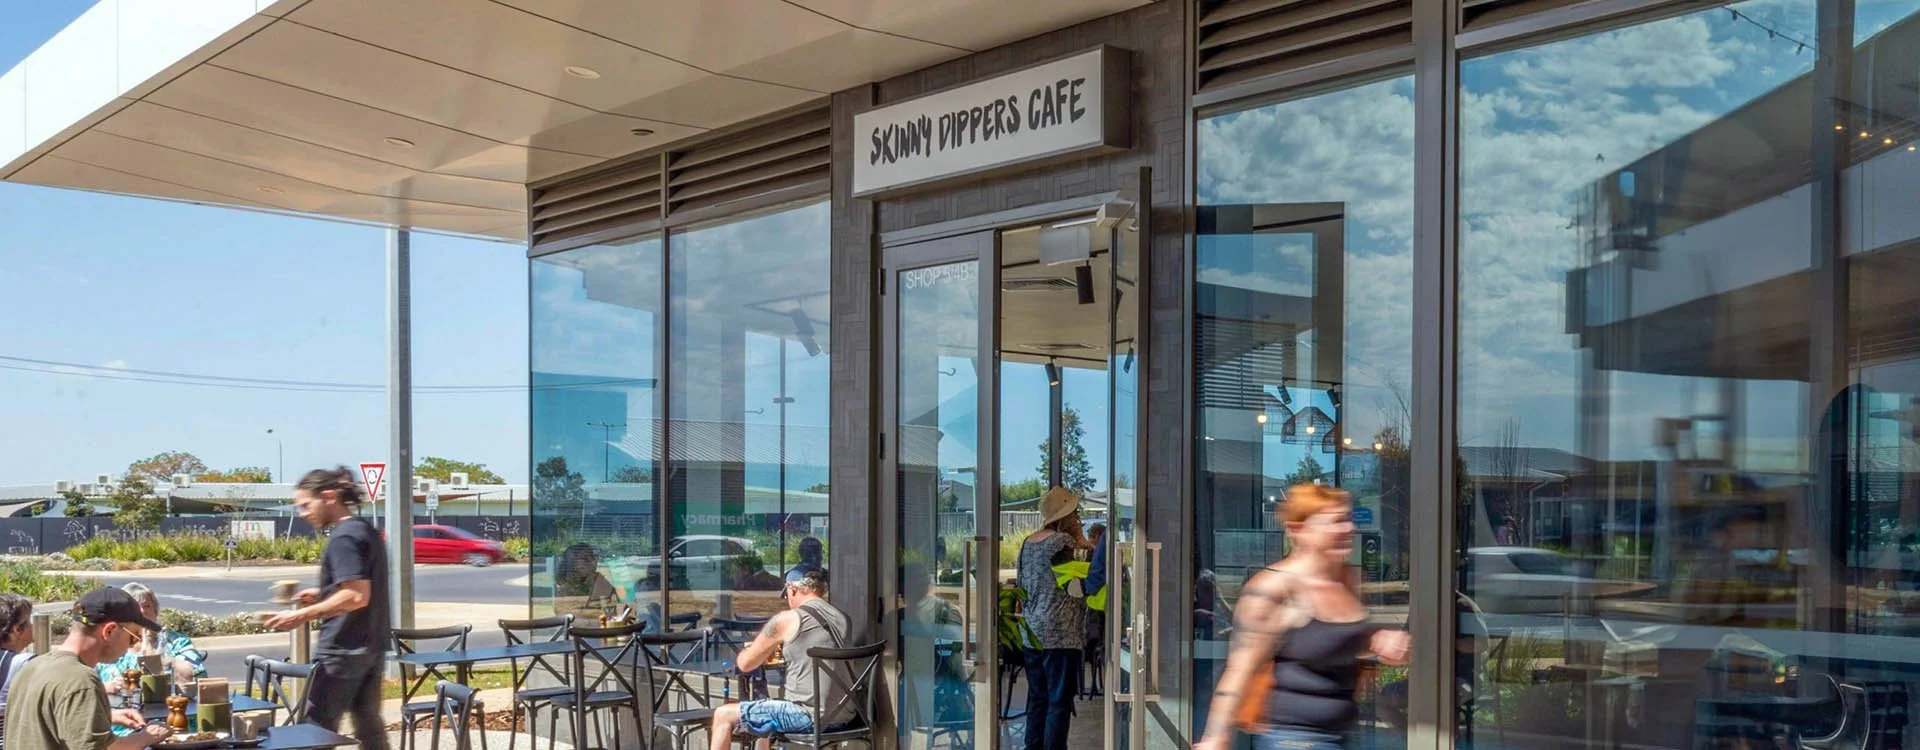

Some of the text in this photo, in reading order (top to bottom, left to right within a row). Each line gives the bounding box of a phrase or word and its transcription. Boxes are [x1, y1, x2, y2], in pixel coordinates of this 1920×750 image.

[870, 77, 1086, 166] SKINNY DIPPERS CAFE
[906, 266, 940, 290] SHOP
